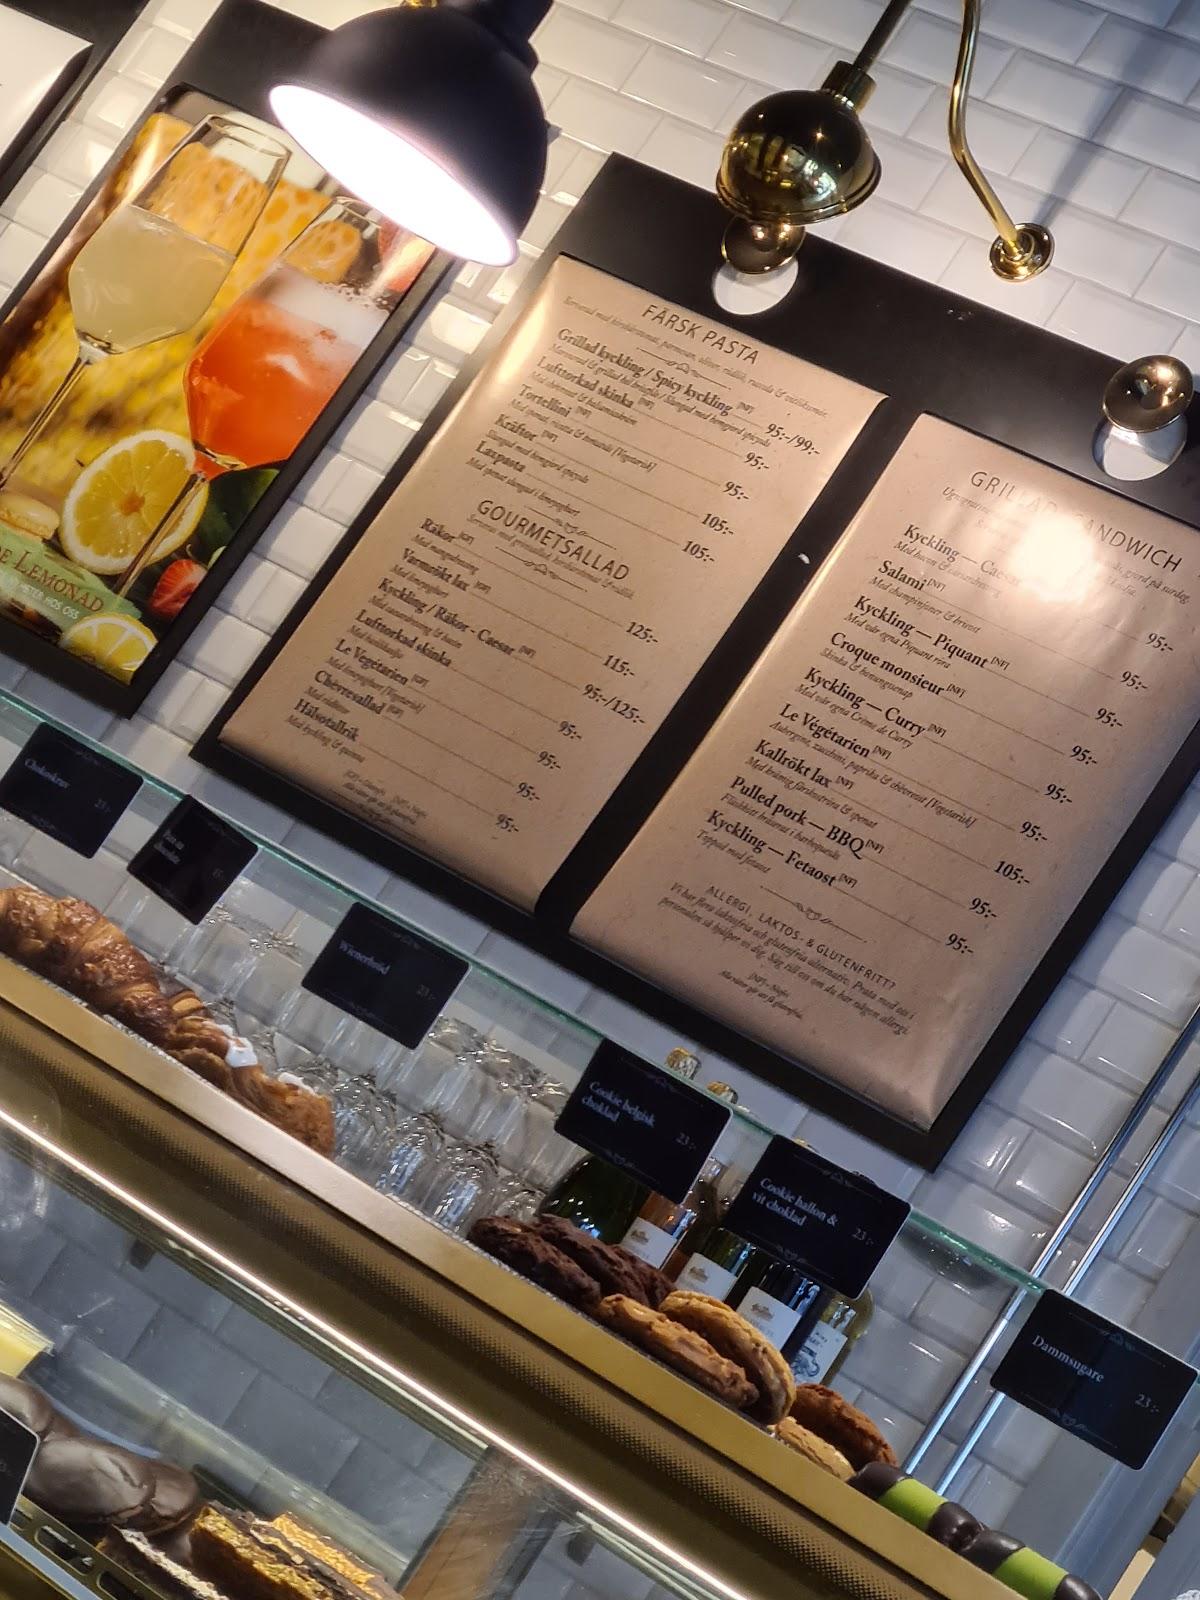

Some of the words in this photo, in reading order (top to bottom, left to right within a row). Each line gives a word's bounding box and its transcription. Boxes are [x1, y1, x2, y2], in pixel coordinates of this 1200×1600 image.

[557, 328, 601, 354] Grillad
[596, 345, 646, 379] kyckling
[650, 369, 684, 395] Spicy
[682, 383, 733, 417] kyckling
[641, 304, 703, 339] FÄRSK
[701, 330, 759, 365] PASTA
[494, 413, 539, 442] Kräftor
[701, 513, 734, 535] 105:-
[519, 383, 573, 418] Tortellini
[722, 481, 749, 500] 95:-
[537, 356, 600, 392] Lufttorkad
[597, 385, 634, 409] skinka
[743, 452, 770, 470] 95:-
[475, 440, 526, 473] Laxpasta
[681, 540, 715, 562] 105:-
[477, 500, 629, 580] GOURMETSALLAD
[419, 517, 457, 543] Räkor
[625, 621, 658, 643] 125:-
[450, 573, 470, 592] lax
[602, 654, 635, 676] 115:-
[878, 560, 927, 591] Salami
[1120, 670, 1149, 690] 95:-
[903, 524, 960, 563] Kyckling
[1145, 632, 1174, 653] 95:-
[334, 638, 352, 656] Le
[536, 750, 561, 770] 95:-
[355, 608, 419, 649] Lufttorkad
[414, 642, 452, 668] skinka
[557, 720, 582, 740] 95:-
[377, 577, 428, 614] Kyckling
[433, 606, 470, 632] Räkor
[476, 628, 516, 656] Caesar
[582, 683, 645, 724] 95:-/125:-
[831, 632, 880, 665] Croque
[879, 660, 945, 696] monsieur
[1069, 745, 1097, 765] 95:-
[854, 595, 916, 638] Kyckling
[932, 633, 988, 669] Piquant
[1095, 707, 1123, 728] 95:-
[516, 782, 540, 801] 95:-
[778, 703, 799, 722] Le
[802, 712, 870, 758] Végétarien
[1019, 821, 1048, 842] 95:-
[804, 667, 866, 710] Kyckling
[884, 707, 926, 738] Curry
[1044, 783, 1073, 804] 95:-
[495, 813, 519, 833] 95:-
[730, 775, 778, 808] Pulled
[771, 803, 807, 826] pork
[825, 824, 871, 860] BBQ
[968, 897, 997, 918] 95:-
[754, 739, 811, 777] Kallrökt
[809, 767, 833, 788] lax
[994, 860, 1030, 884] 105:-
[706, 809, 768, 854] Kyckling
[784, 849, 836, 887] Fetaost
[945, 933, 974, 954] 95:-
[816, 943, 896, 990] GLUTENFRITT?
[590, 1082, 622, 1106] Cookie
[760, 1178, 796, 1203] Cookie
[796, 1195, 827, 1222] hallon
[1032, 1335, 1104, 1383] Dammsugare
